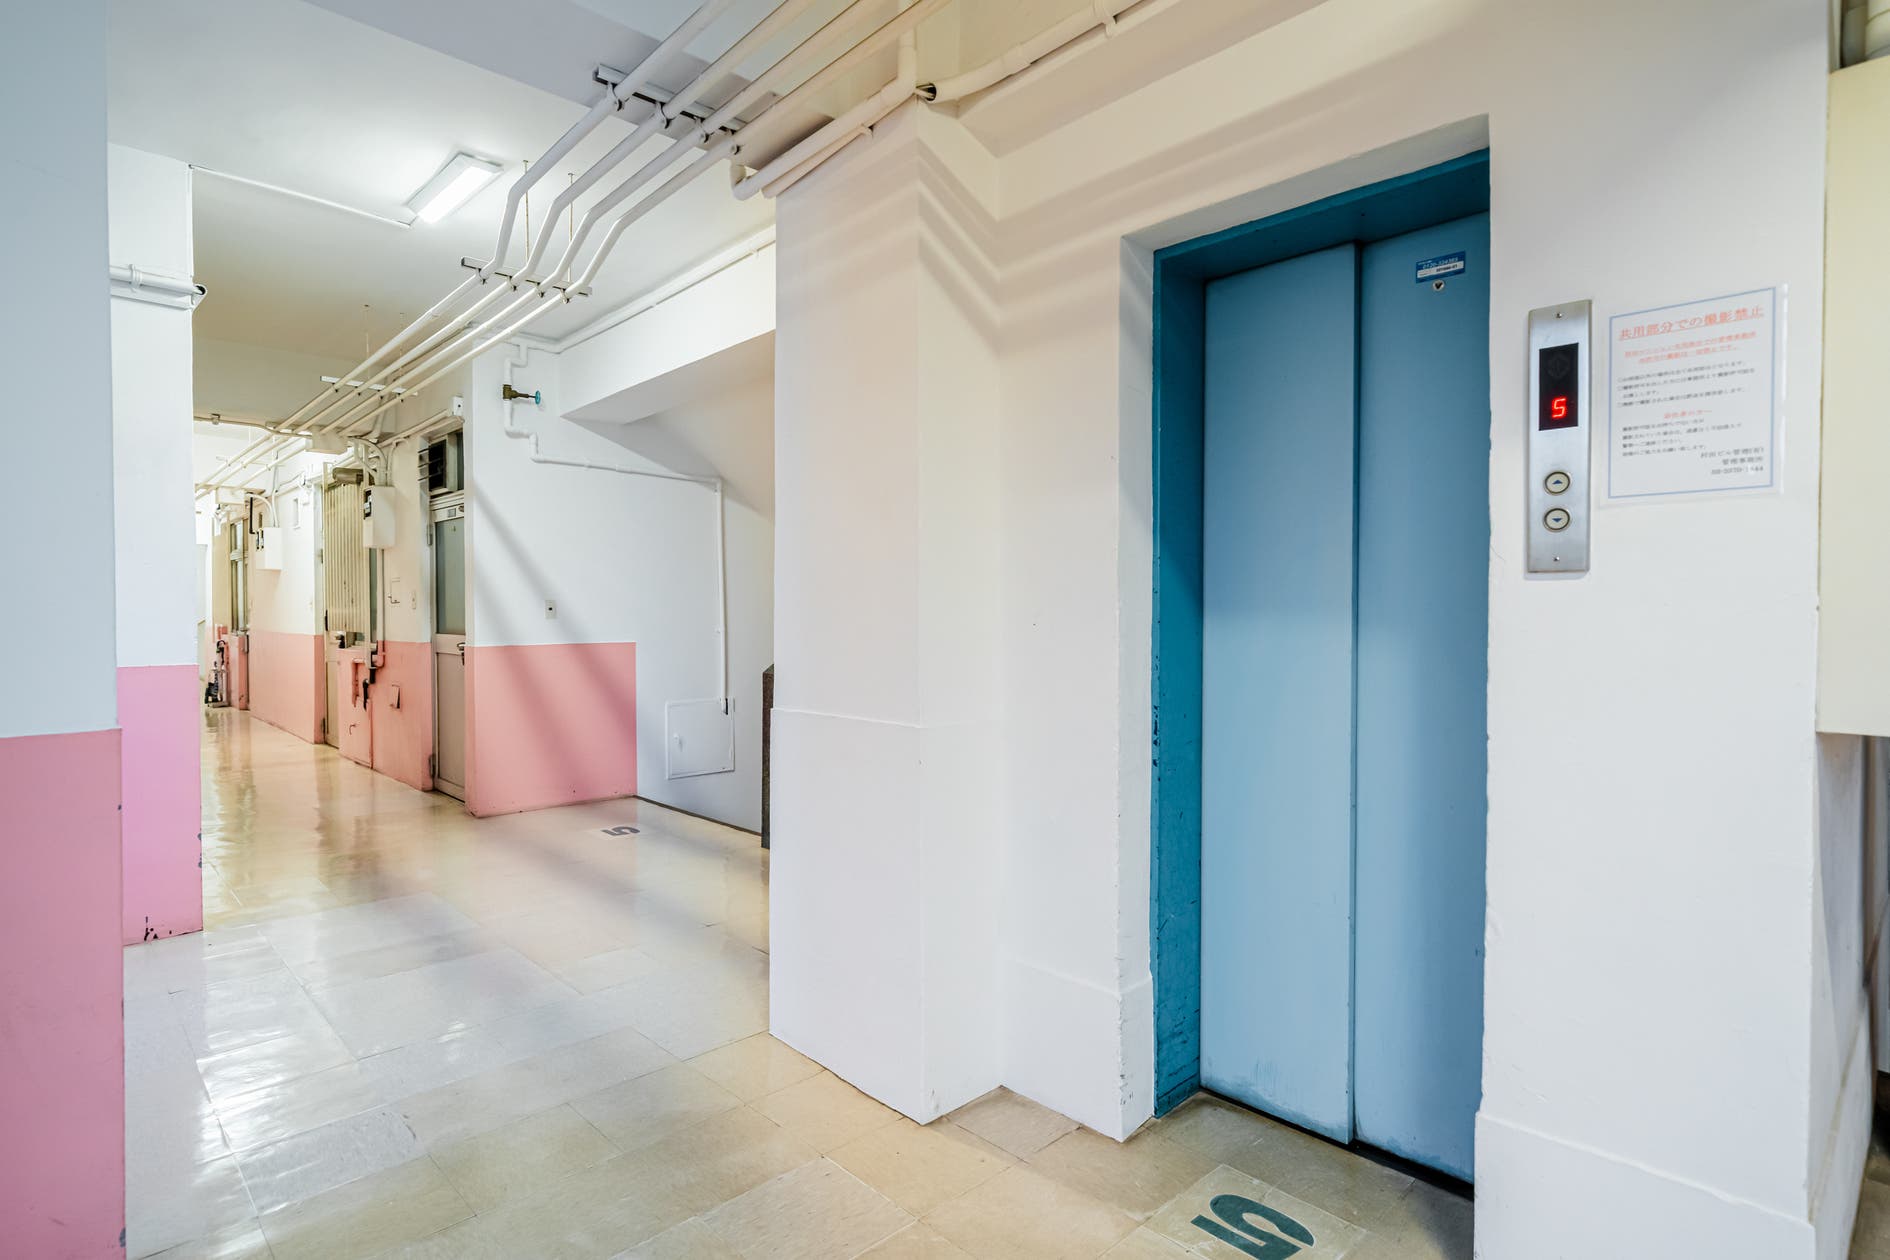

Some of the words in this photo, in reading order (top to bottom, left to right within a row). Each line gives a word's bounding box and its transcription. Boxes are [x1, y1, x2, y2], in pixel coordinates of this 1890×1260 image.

[1619, 306, 1764, 340] 共用部分での撮影禁止
[1552, 397, 1567, 419] 5
[600, 826, 641, 836] 5
[1190, 1194, 1315, 1260] 5
